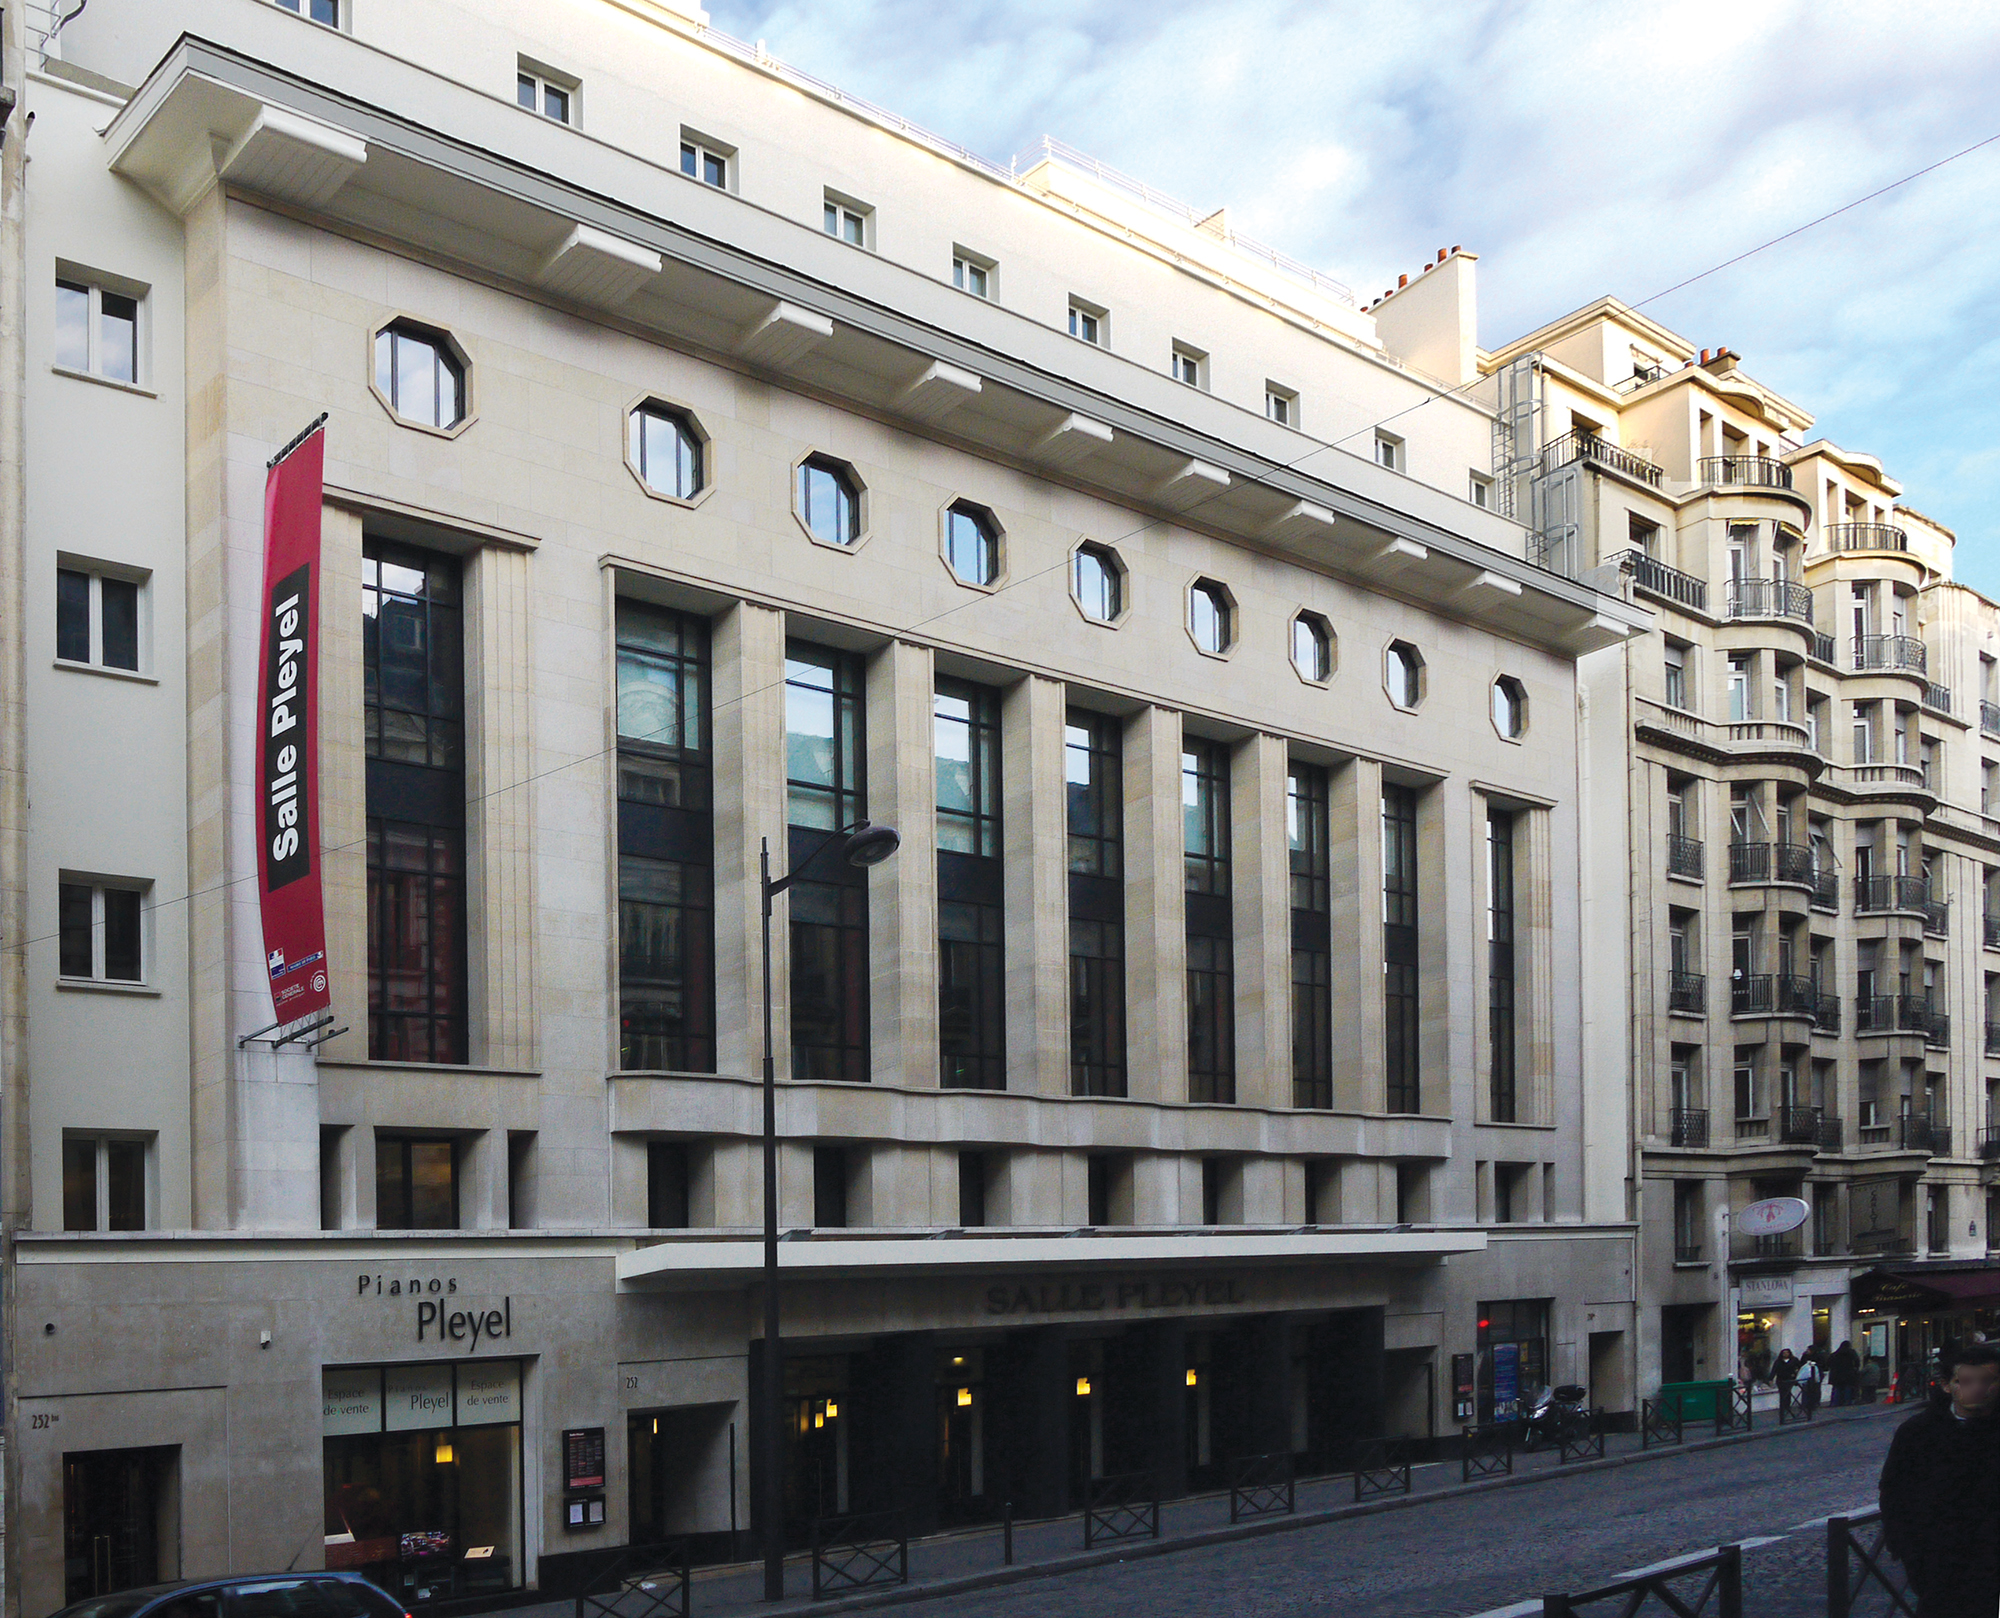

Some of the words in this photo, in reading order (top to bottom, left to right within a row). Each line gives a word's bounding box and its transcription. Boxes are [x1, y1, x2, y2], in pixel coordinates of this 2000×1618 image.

[271, 593, 303, 738] Pleyel
[272, 744, 299, 862] Salle
[358, 1275, 457, 1295] Pianos
[986, 1284, 1106, 1315] SALLE
[1118, 1279, 1246, 1309] PLEYEL
[418, 1296, 511, 1353] Pleyel
[388, 1384, 428, 1394] Pianos
[470, 1379, 505, 1393] Espace
[626, 1376, 638, 1389] 252
[327, 1388, 365, 1402] Espace
[410, 1392, 450, 1413] Pleyel
[467, 1395, 480, 1406] de
[482, 1394, 509, 1405] vente
[323, 1404, 337, 1416] de
[340, 1403, 370, 1414] vente
